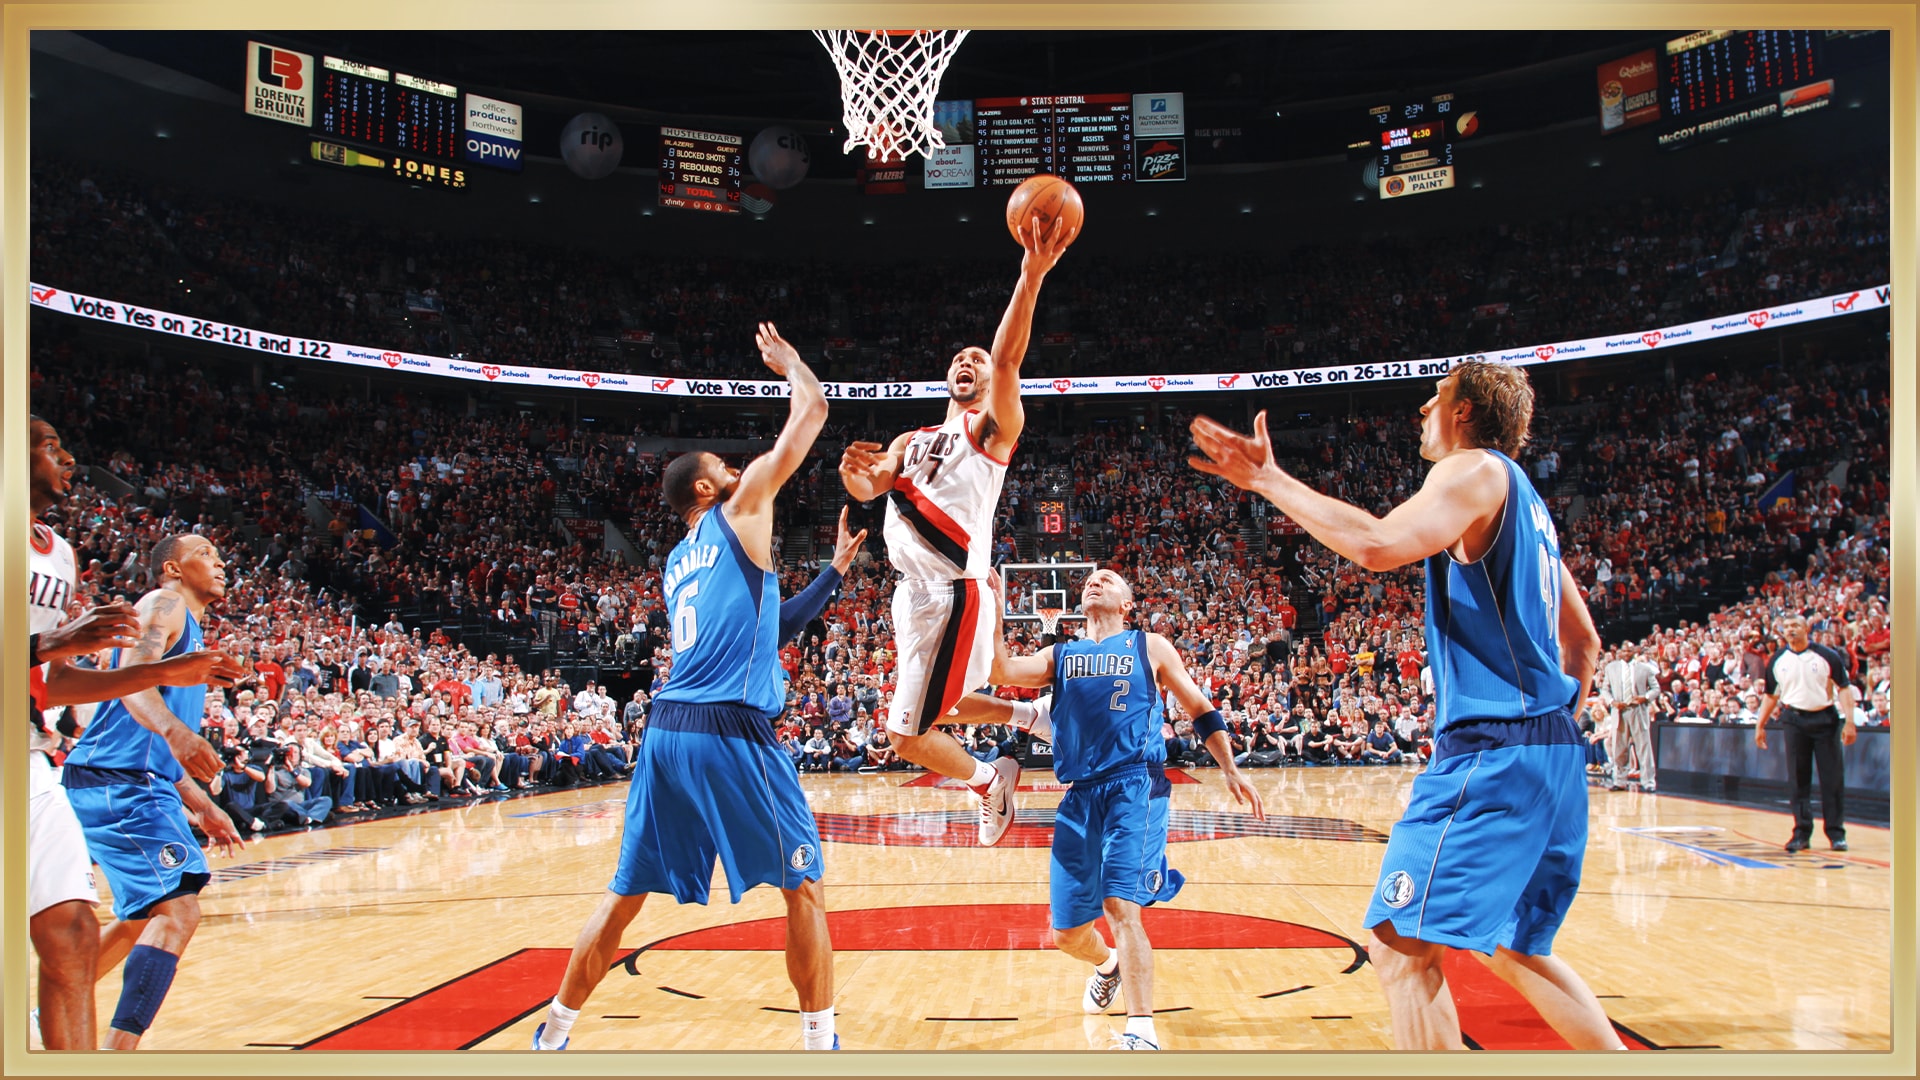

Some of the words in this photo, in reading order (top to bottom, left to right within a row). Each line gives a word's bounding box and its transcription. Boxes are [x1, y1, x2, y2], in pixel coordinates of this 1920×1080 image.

[343, 60, 370, 71] HOME
[255, 87, 305, 106] LORENTZ
[1031, 96, 1052, 105] STATS
[1055, 96, 1086, 105] CENTRAL
[255, 98, 305, 118] BRUUN
[482, 102, 506, 114] office
[1405, 104, 1423, 115] 2:34
[1438, 102, 1450, 113] 80
[470, 109, 517, 125] products
[1056, 116, 1065, 124] 30
[1120, 114, 1130, 122] 24
[1377, 114, 1388, 123] 72
[1659, 126, 1696, 145] McCOY
[1698, 103, 1778, 134] FREIGHTLINER
[472, 120, 516, 135] northwest
[1194, 128, 1211, 137] RISE
[1212, 128, 1231, 136] WITH
[1232, 127, 1242, 136] US
[1390, 127, 1408, 139] SAN
[1411, 128, 1431, 139] 4:30
[581, 125, 613, 153] rip
[666, 128, 737, 143] HUSTLEBOARD
[990, 138, 1003, 146] FREE
[1390, 137, 1412, 148] MEM
[466, 139, 521, 161] opnw
[664, 139, 695, 149] BLAZERS
[716, 145, 739, 154] GUEST
[951, 147, 961, 155] all
[1445, 144, 1452, 154] 2
[668, 147, 675, 157] 8
[676, 149, 705, 161] BLOCKED
[706, 153, 726, 163] SHOTS
[735, 155, 740, 165] 2
[998, 157, 1024, 165] POINTERS
[1072, 155, 1097, 163] CHARGES
[1098, 154, 1115, 162] TAKEN
[1142, 153, 1180, 172] Pizza
[1383, 155, 1390, 165] 3
[392, 157, 465, 182] JONES
[662, 158, 675, 170] 33
[679, 161, 723, 174] REBOUNDS
[1006, 167, 1036, 175] REBOUNDS
[1093, 164, 1112, 172] FOULS
[1148, 161, 1176, 176] Hut
[395, 169, 433, 182] SODA
[682, 174, 720, 186] STEALS
[734, 179, 740, 188] 4
[874, 170, 905, 181] BLAZERS
[1093, 174, 1114, 182] POINTS
[1408, 169, 1447, 183] MILLER
[1412, 179, 1443, 191] PAINT
[661, 184, 675, 195] 48
[685, 187, 717, 199] TOTAL
[727, 191, 740, 201] 42
[664, 199, 685, 208] xfinity
[69, 294, 116, 319] Vote
[122, 305, 155, 328] Yes
[161, 316, 184, 334] on
[191, 319, 252, 346] 26-121
[259, 335, 291, 354] and
[298, 340, 332, 358] 122
[1711, 319, 1747, 331] Portland
[1748, 314, 1768, 324] YES
[1770, 308, 1803, 320] Schools
[1605, 336, 1641, 348] Portland
[1643, 333, 1661, 343] YES
[1663, 328, 1693, 340] Schools
[347, 350, 381, 362] Portland
[383, 353, 401, 364] YES
[402, 357, 431, 368] Schools
[1501, 351, 1535, 362] Portland
[1537, 347, 1554, 357] YES
[1556, 345, 1586, 355] Schools
[449, 363, 481, 374] Portland
[482, 366, 500, 377] YES
[501, 370, 530, 380] Schools
[1252, 373, 1289, 387] Vote
[1294, 370, 1322, 384] Yes
[1327, 369, 1348, 381] on
[1354, 363, 1412, 380] 26-121
[1418, 358, 1450, 375] and
[548, 373, 581, 382] Portland
[582, 374, 599, 385] YES
[600, 377, 628, 386] Schools
[1021, 382, 1052, 390] Portland
[1053, 379, 1070, 389] YES
[1072, 381, 1098, 389] Schools
[1115, 379, 1147, 388] Portland
[1148, 377, 1165, 387] YES
[1167, 378, 1194, 387] Schools
[686, 381, 723, 395] Vote
[728, 381, 756, 395] Yes
[761, 384, 781, 396] on
[848, 383, 877, 397] and
[883, 384, 912, 397] 122
[926, 456, 944, 485] 7
[1040, 501, 1064, 513] 2:34
[1045, 514, 1062, 534] 13
[673, 579, 699, 654] 6
[1064, 653, 1135, 681] DALLAS
[1109, 679, 1131, 712] 2
